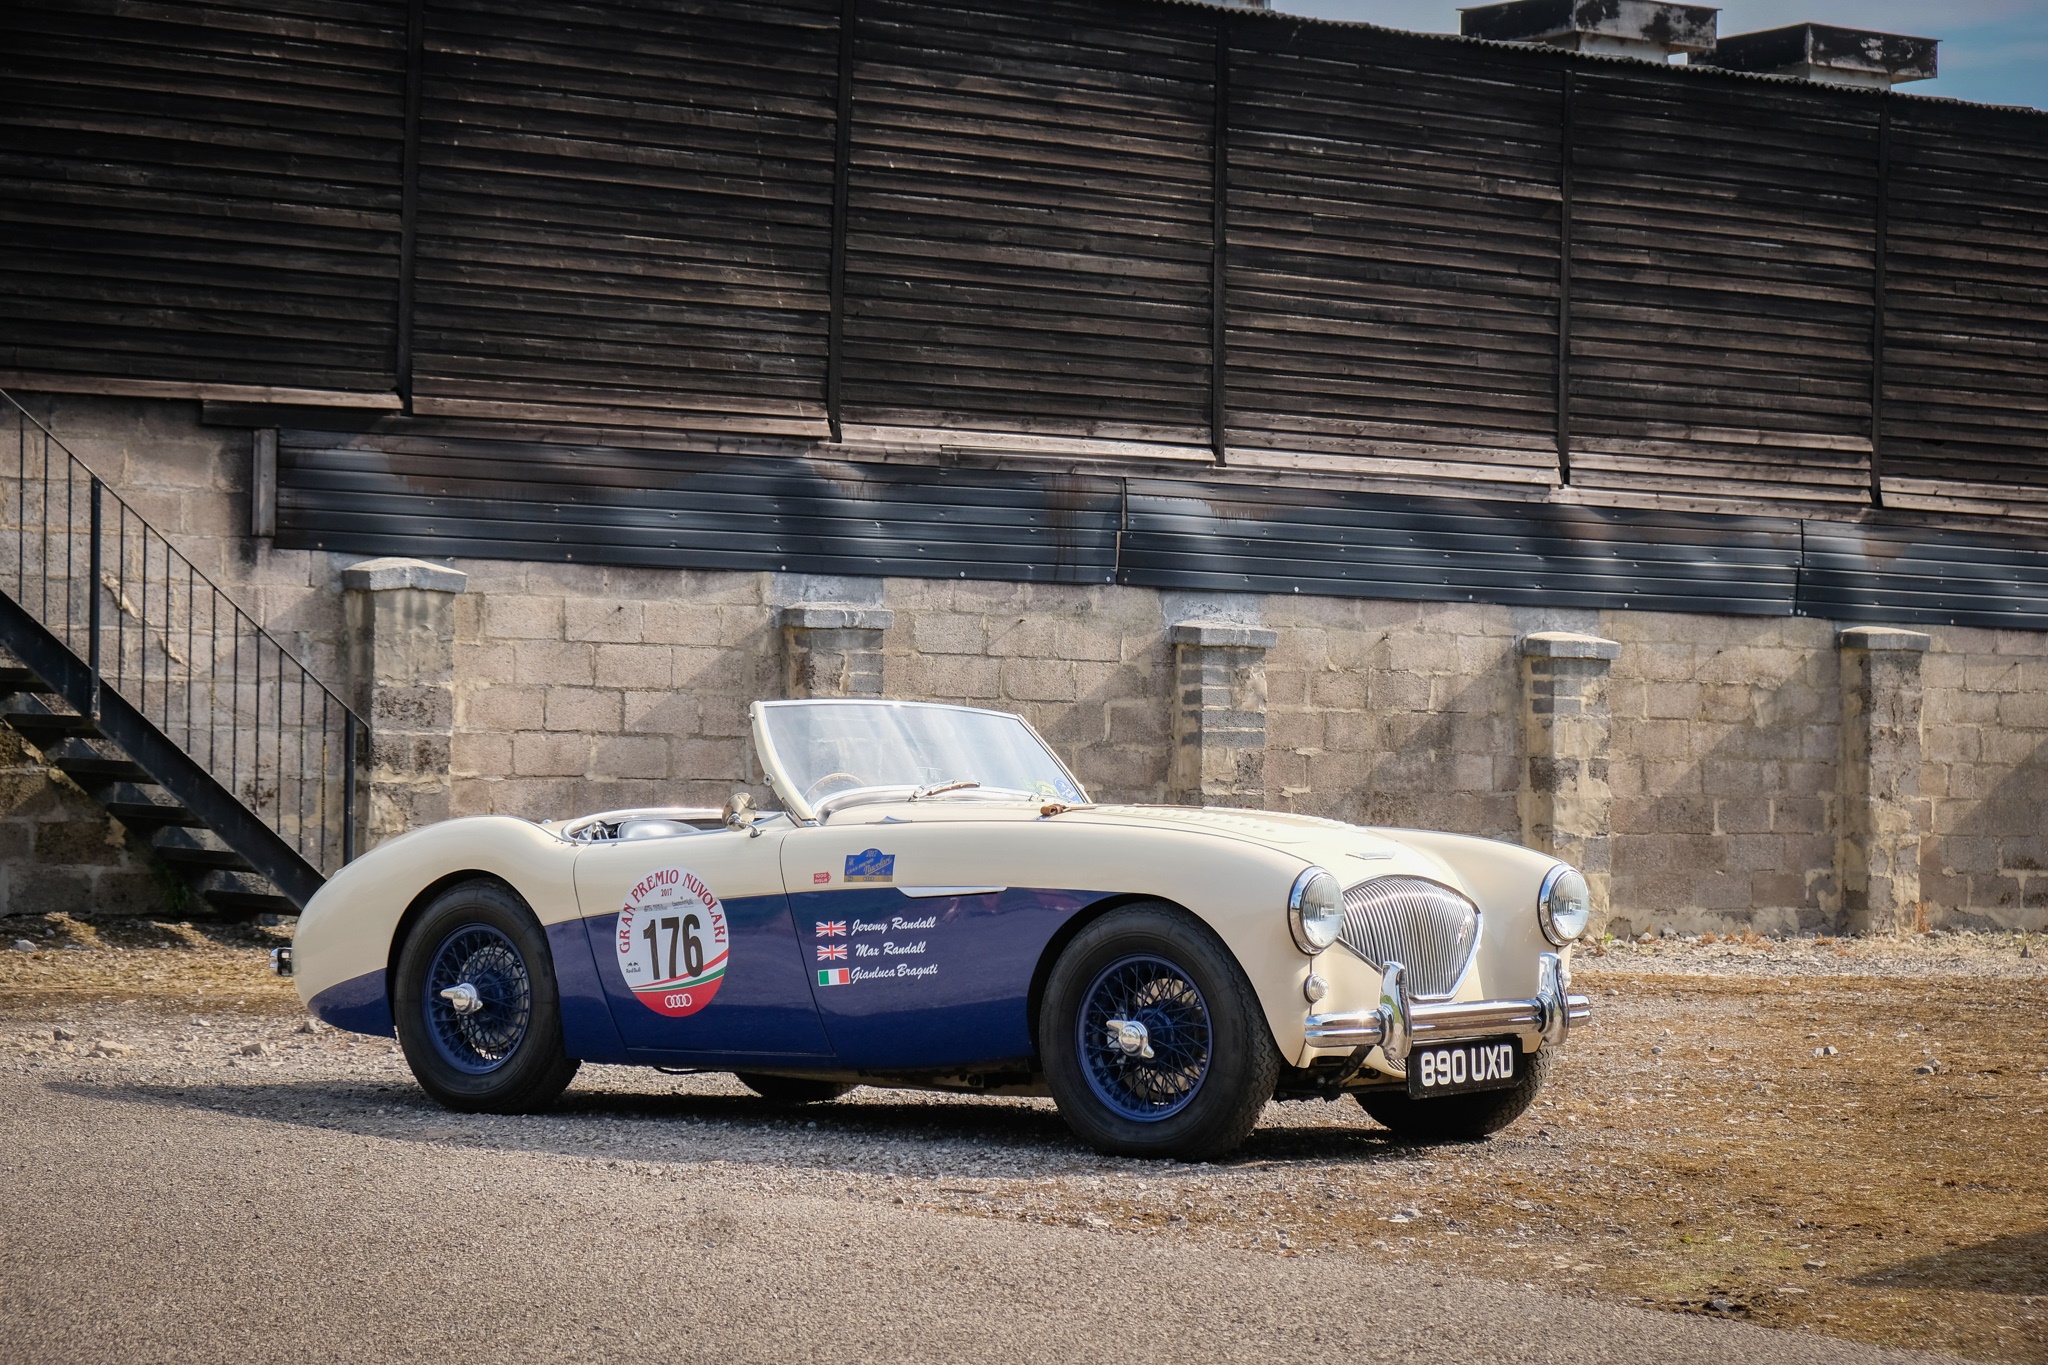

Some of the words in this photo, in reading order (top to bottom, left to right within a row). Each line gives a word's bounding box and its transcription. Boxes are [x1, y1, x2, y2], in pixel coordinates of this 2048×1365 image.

[661, 888, 673, 897] 2017
[619, 903, 636, 954] GRAN
[631, 869, 679, 903] PREMIO
[682, 872, 726, 943] NUVOLARI
[851, 919, 888, 936] Jeremy
[891, 916, 937, 930] Randall
[643, 913, 703, 980] 176
[855, 943, 880, 957] Max
[883, 940, 927, 955] Randall
[850, 966, 896, 984] Gianluca
[896, 963, 938, 980] Braguti
[1421, 1049, 1466, 1087] 890
[1471, 1044, 1514, 1081] UXD
